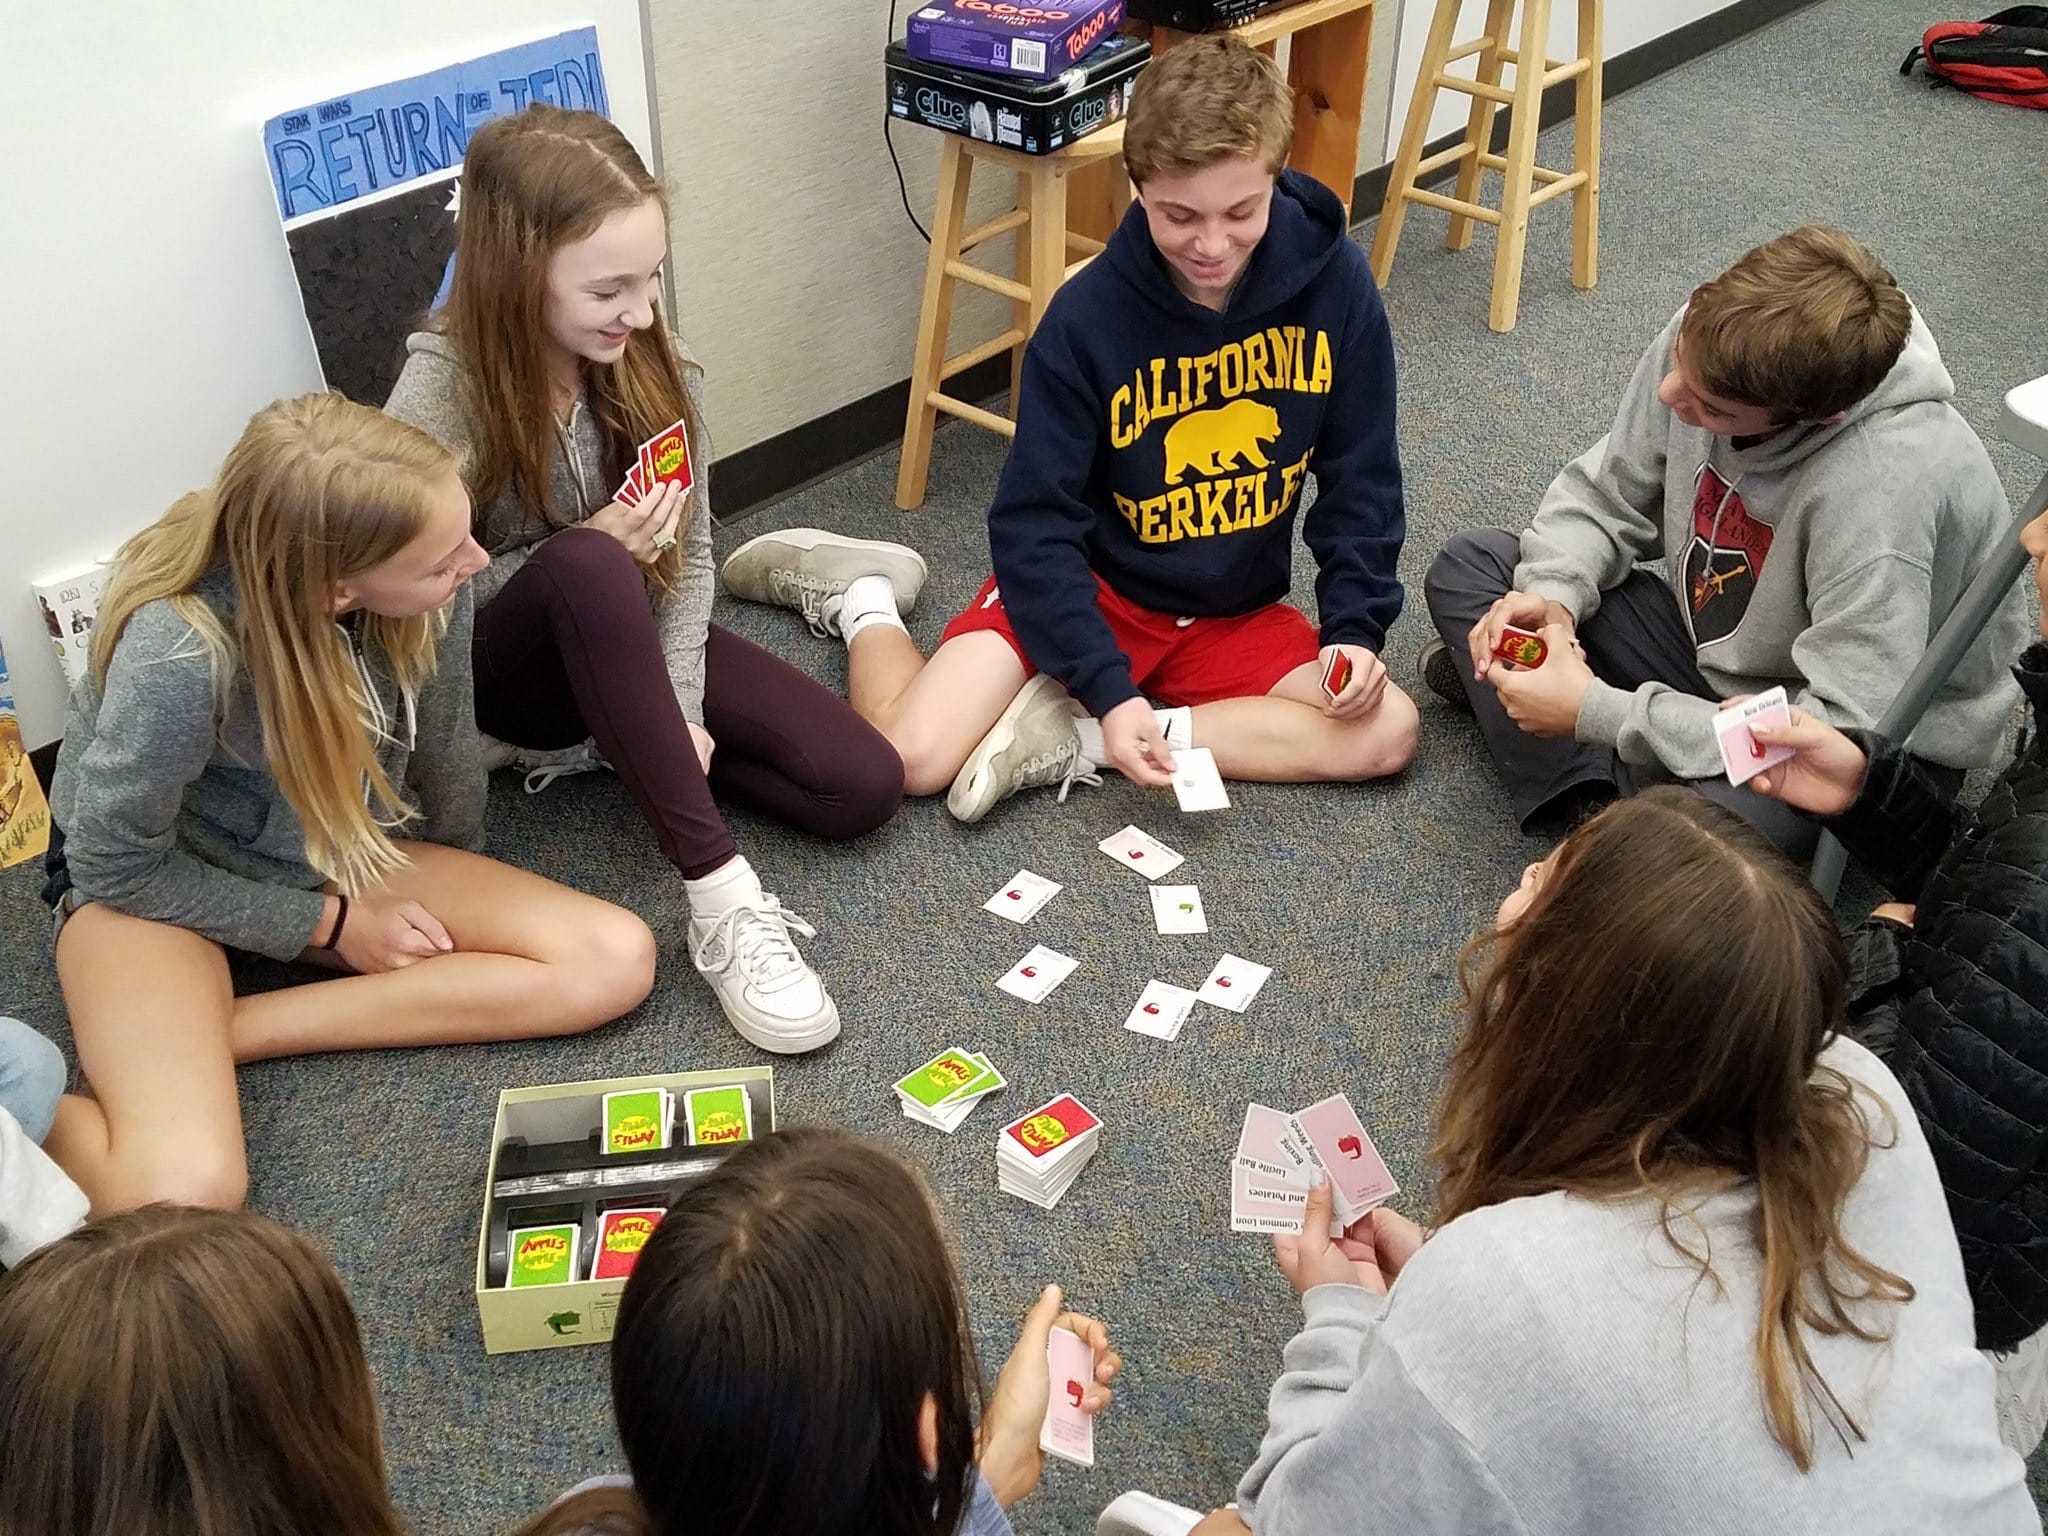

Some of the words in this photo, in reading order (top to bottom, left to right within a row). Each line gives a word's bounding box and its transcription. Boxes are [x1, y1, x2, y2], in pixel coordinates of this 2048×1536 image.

[1066, 11, 1105, 60] Taboo
[284, 113, 311, 133] STAR
[319, 100, 352, 122] WARS
[915, 87, 966, 123] Clue
[1069, 99, 1105, 130] Clue
[274, 93, 468, 217] RETURN
[470, 92, 488, 110] OF
[1110, 326, 1333, 449] CALIFORNIA
[1113, 446, 1315, 544] BERKELE
[1290, 1119, 1308, 1146] Weeds
[1239, 1156, 1256, 1169] Ball
[1280, 1137, 1304, 1166] Boxing
[1305, 1144, 1323, 1169] ulling
[1258, 1163, 1286, 1178] Lucille
[1248, 1189, 1286, 1202] Potatoes
[1286, 1193, 1305, 1203] and
[1236, 1216, 1257, 1226] Loon
[1260, 1218, 1299, 1230] Common
